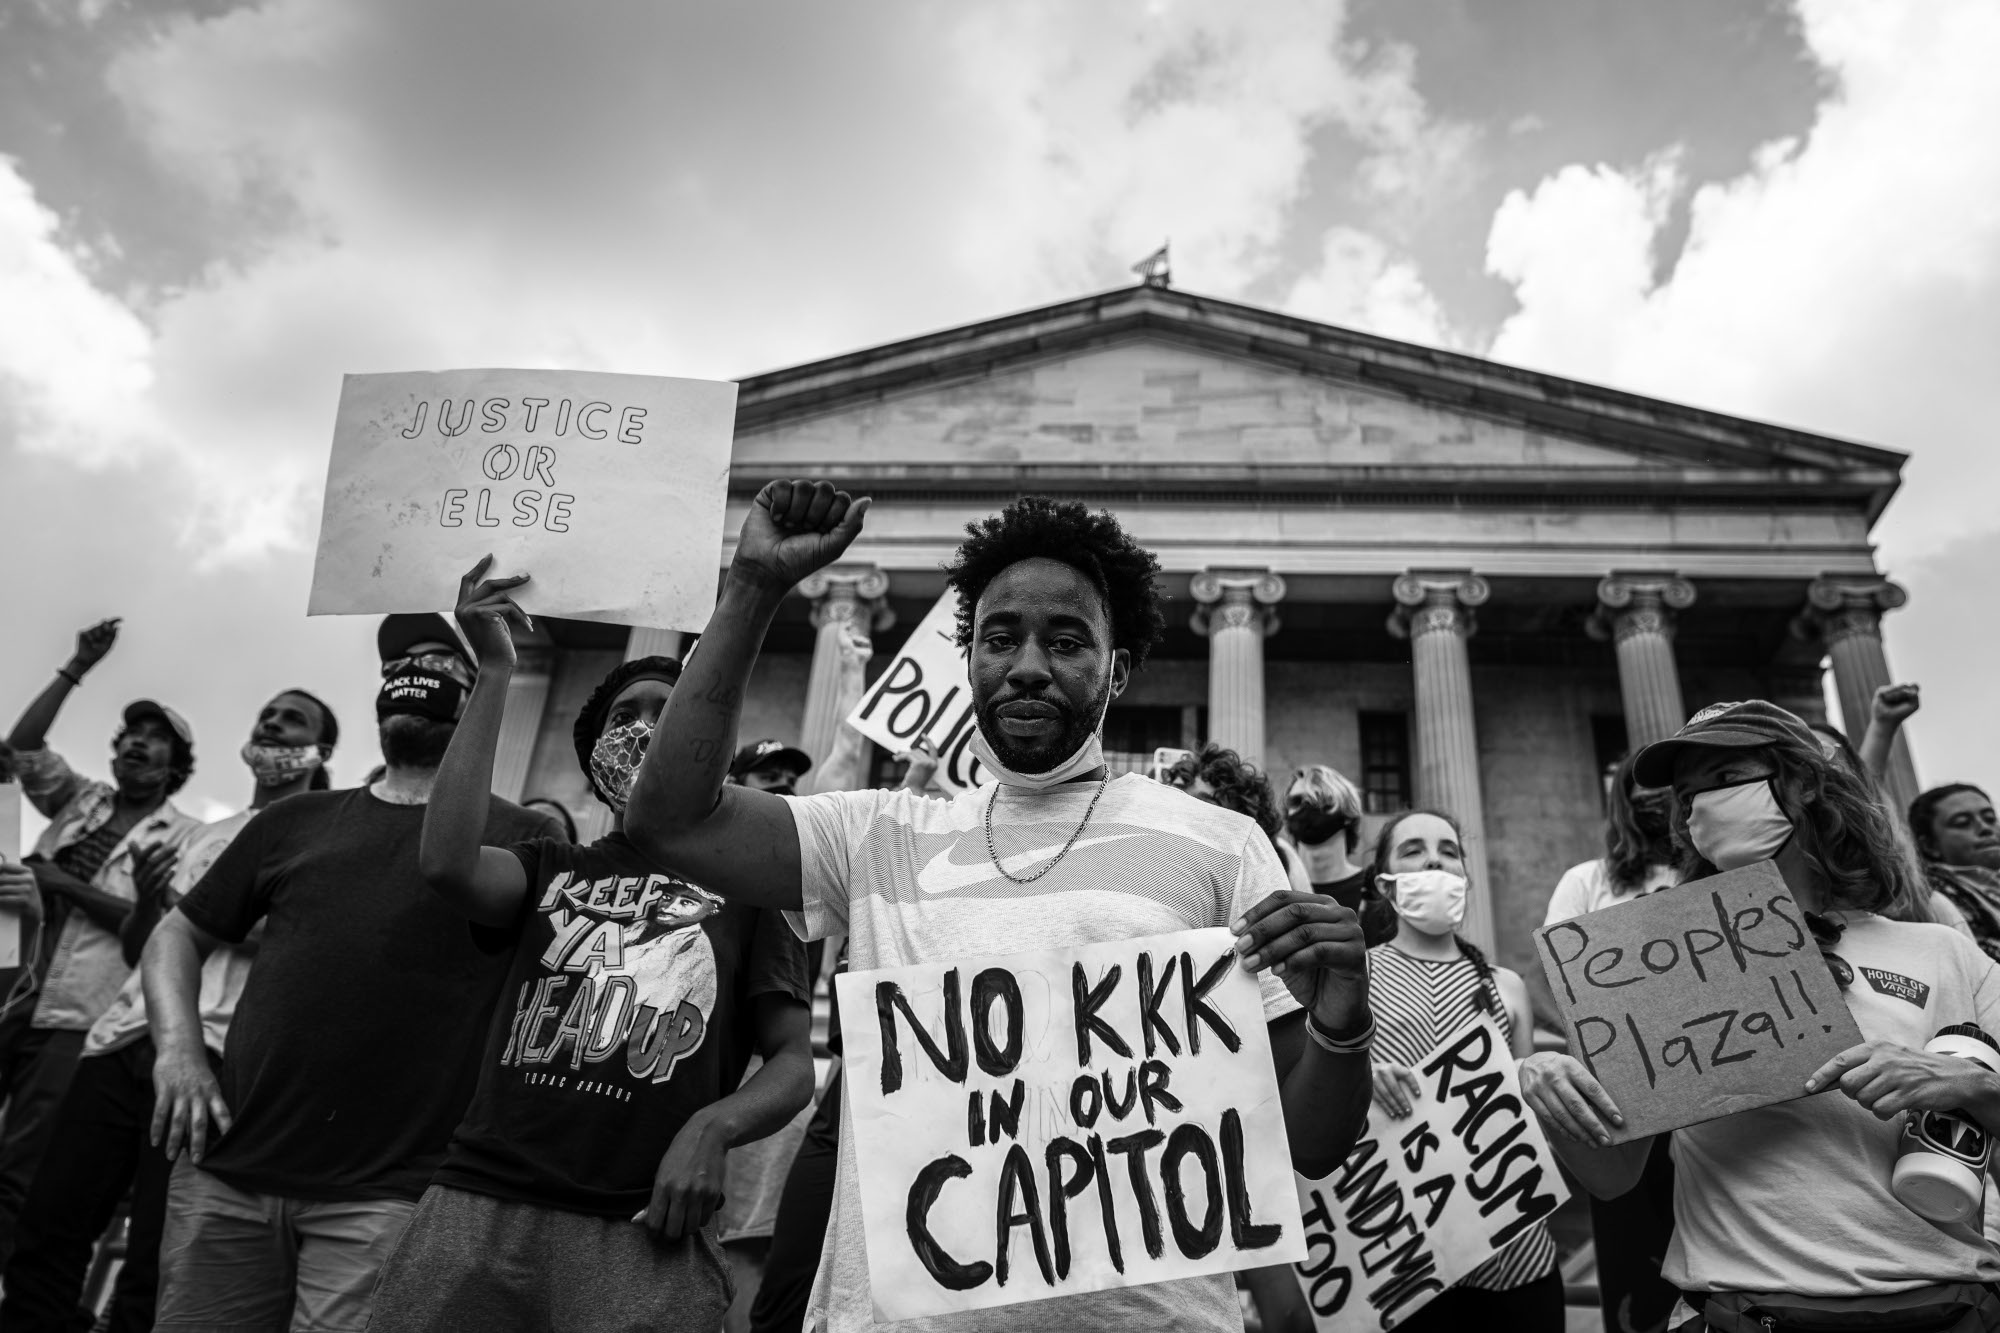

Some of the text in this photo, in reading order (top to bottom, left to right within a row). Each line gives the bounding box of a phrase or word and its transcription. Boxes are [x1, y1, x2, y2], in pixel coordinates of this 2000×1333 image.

[402, 397, 647, 444] JUSTICE
[482, 444, 556, 487] OR
[440, 488, 575, 533] ELSE
[391, 687, 427, 699] MATTER
[413, 676, 440, 689] LIVES
[537, 870, 670, 920] KEEP
[540, 907, 624, 972] YA
[1866, 969, 1925, 993] HOUSE OF
[1880, 980, 1917, 998] VANS
[500, 975, 638, 1070] HEAD
[627, 1000, 706, 1084] UP
[876, 948, 1242, 1096] NO KKK
[525, 1072, 632, 1102] TUPAC SHAKUR
[968, 1078, 1024, 1146] IN
[1070, 1059, 1183, 1128] OUR
[1422, 1025, 1557, 1249] RACISM
[906, 1107, 1282, 1291] CAPITOL
[1400, 1120, 1456, 1228] IS A
[1295, 1189, 1352, 1317] TOO
[1332, 1116, 1445, 1331] ANDEMIC
